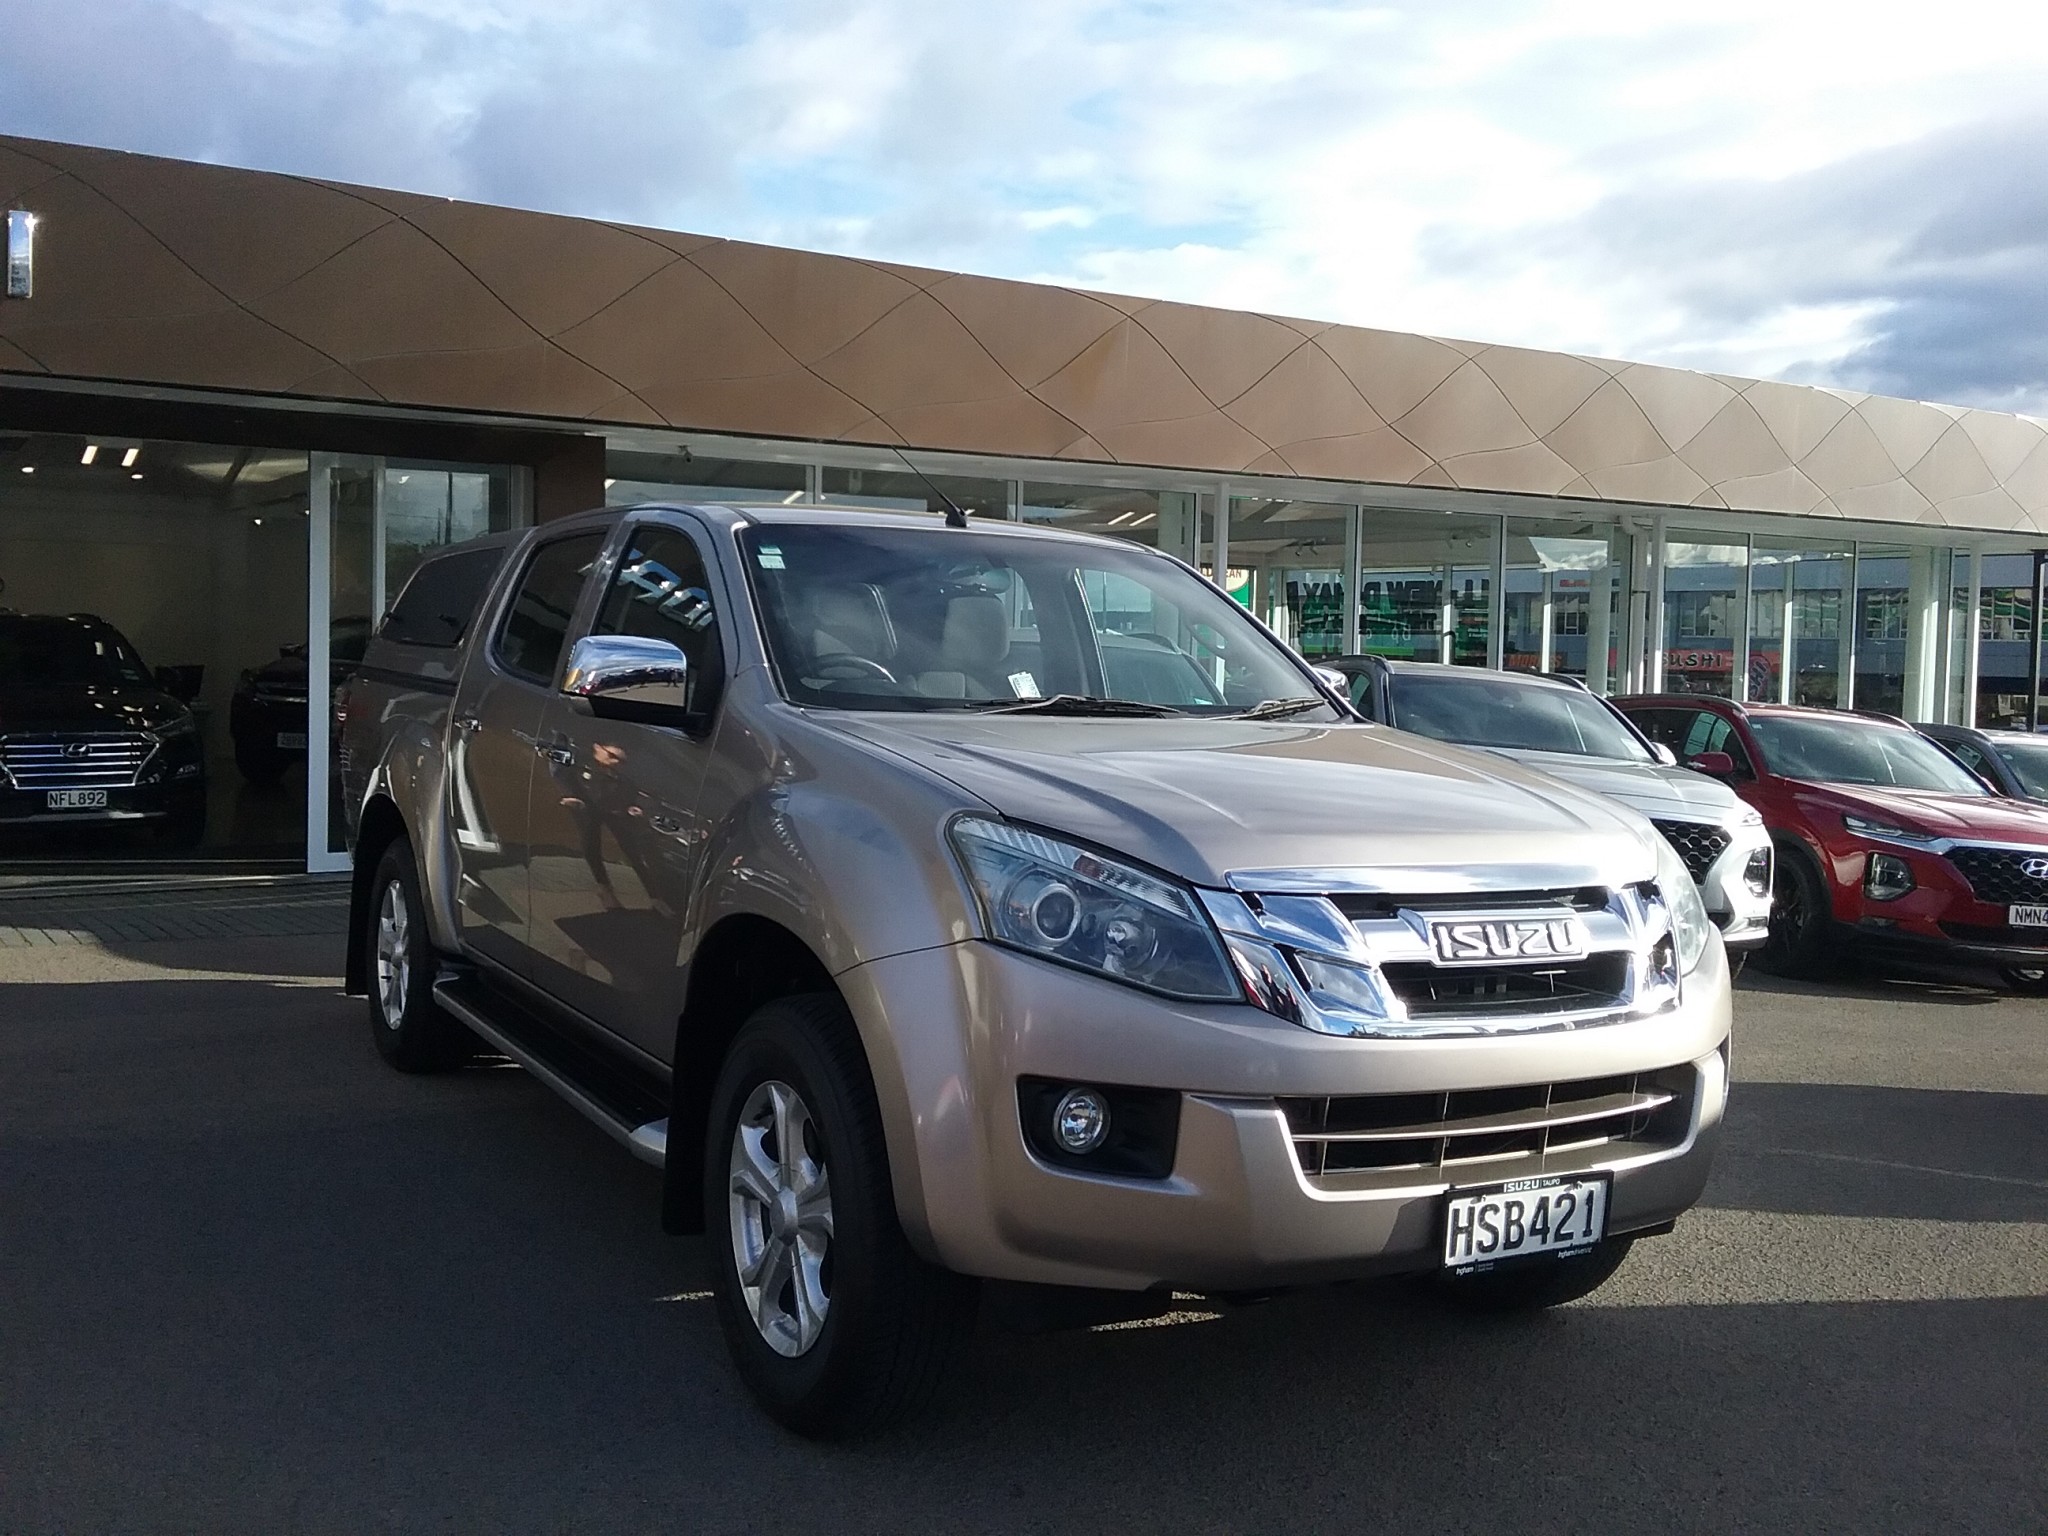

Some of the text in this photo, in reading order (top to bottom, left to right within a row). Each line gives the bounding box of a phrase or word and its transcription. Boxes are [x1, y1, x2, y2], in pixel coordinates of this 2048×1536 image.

[48, 791, 105, 806] NFL892
[1437, 919, 1581, 959] ISUZU
[1503, 1178, 1560, 1193] ISUZU TAUPO
[1448, 1189, 1595, 1258] HSB421
